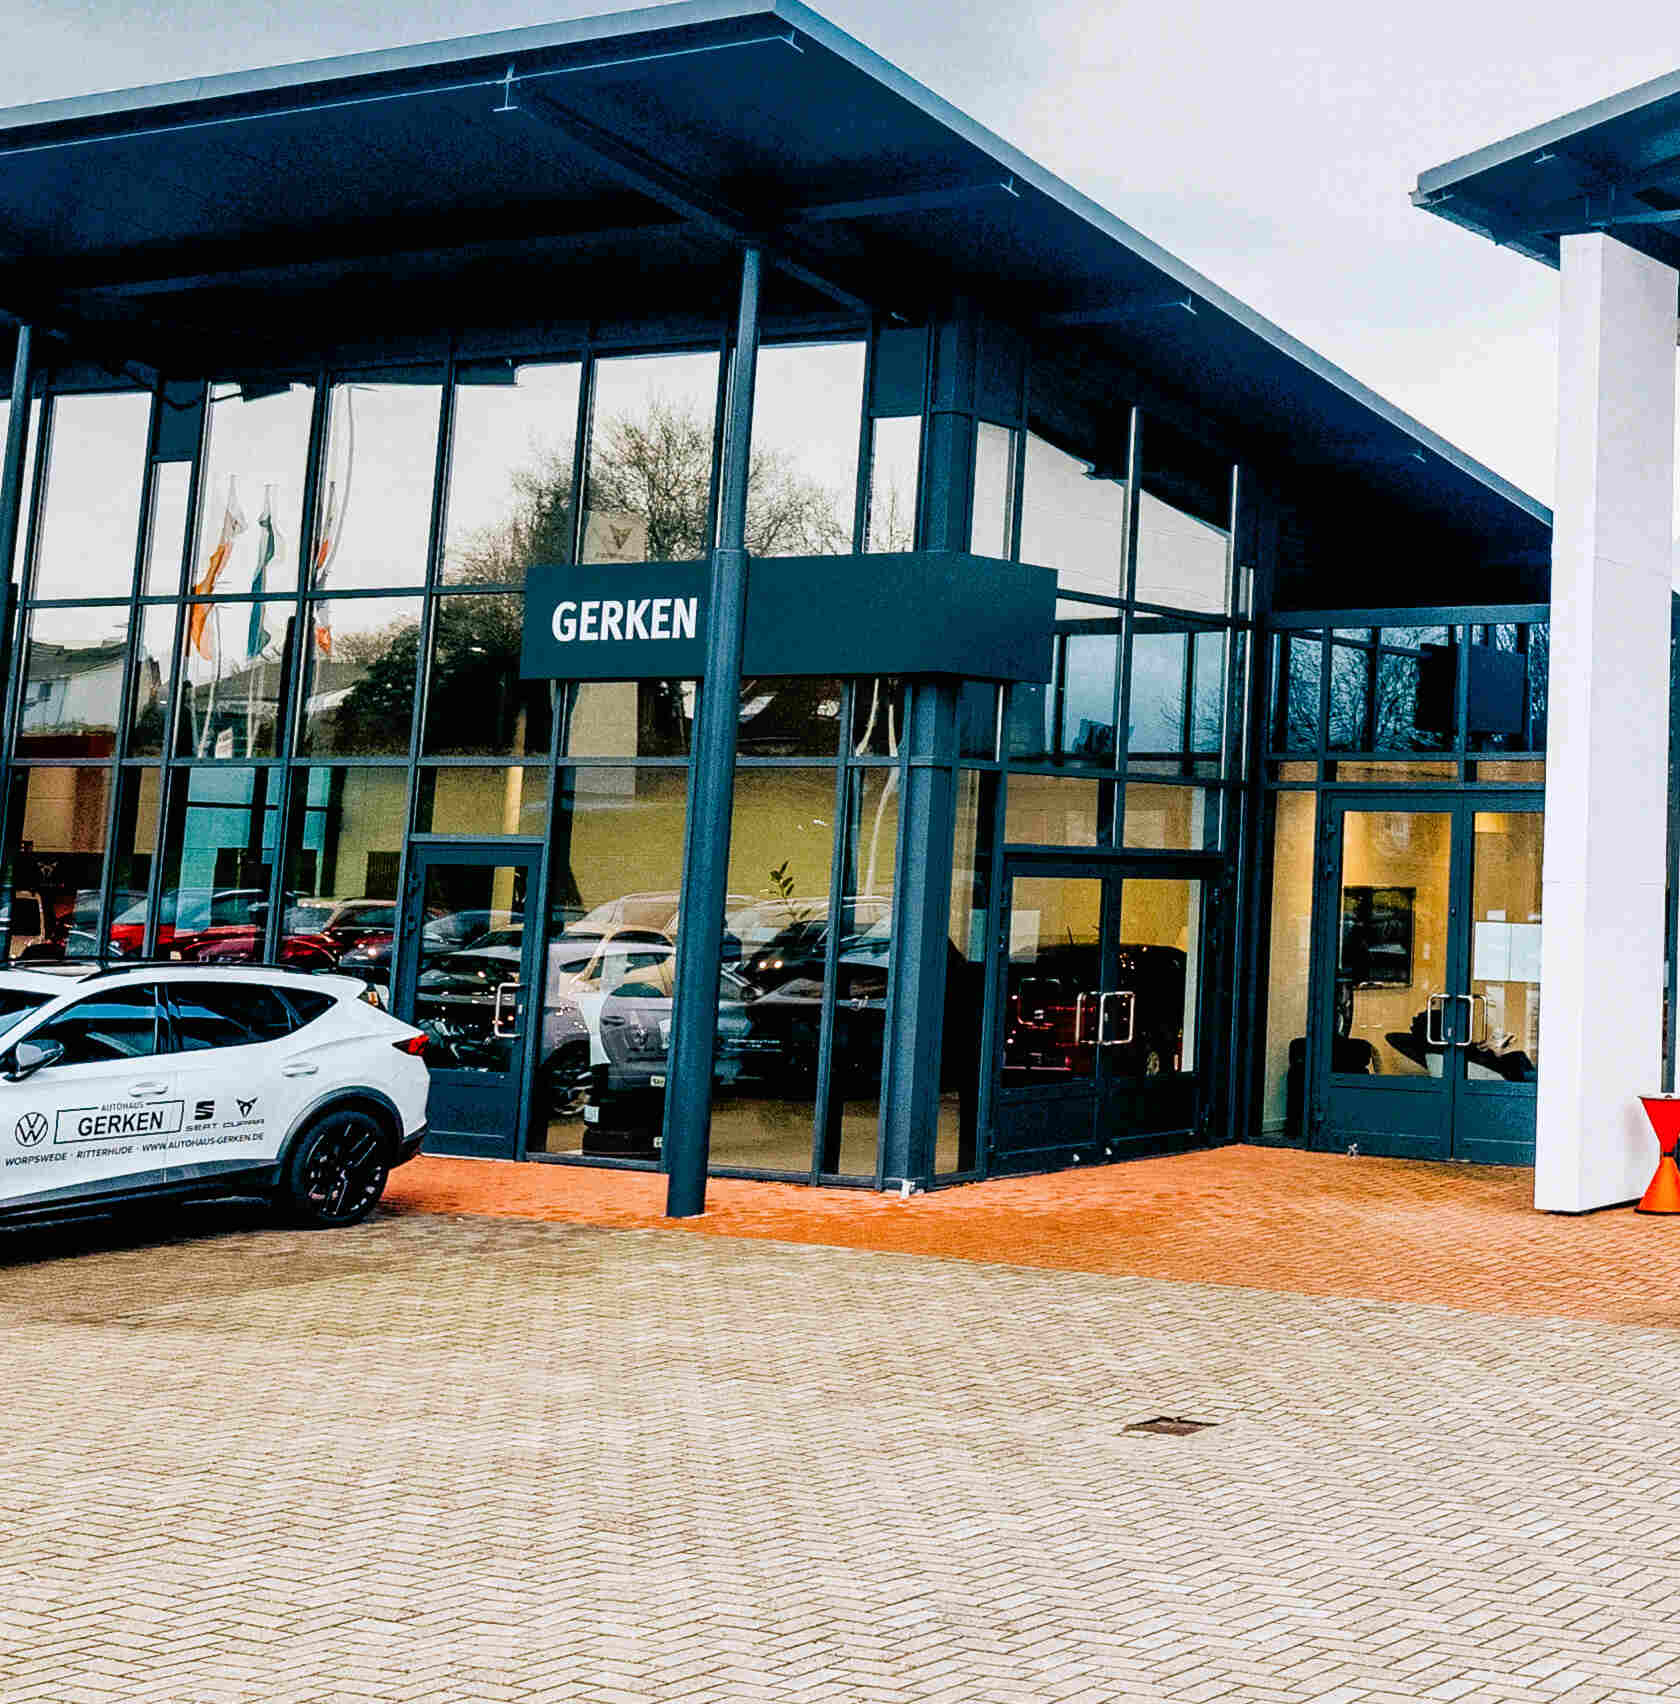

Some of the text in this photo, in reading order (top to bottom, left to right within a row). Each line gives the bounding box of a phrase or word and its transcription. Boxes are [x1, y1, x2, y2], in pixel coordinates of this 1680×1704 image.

[551, 597, 698, 642] GERKEN
[100, 1101, 145, 1112] AUTOHAUS
[77, 1110, 164, 1137] GERKEN
[185, 1123, 218, 1132] SEAT
[4, 1131, 265, 1167] WORPSWEDE RITTERHUDE WWW.AUTOHAUS-GERKEN.DE
